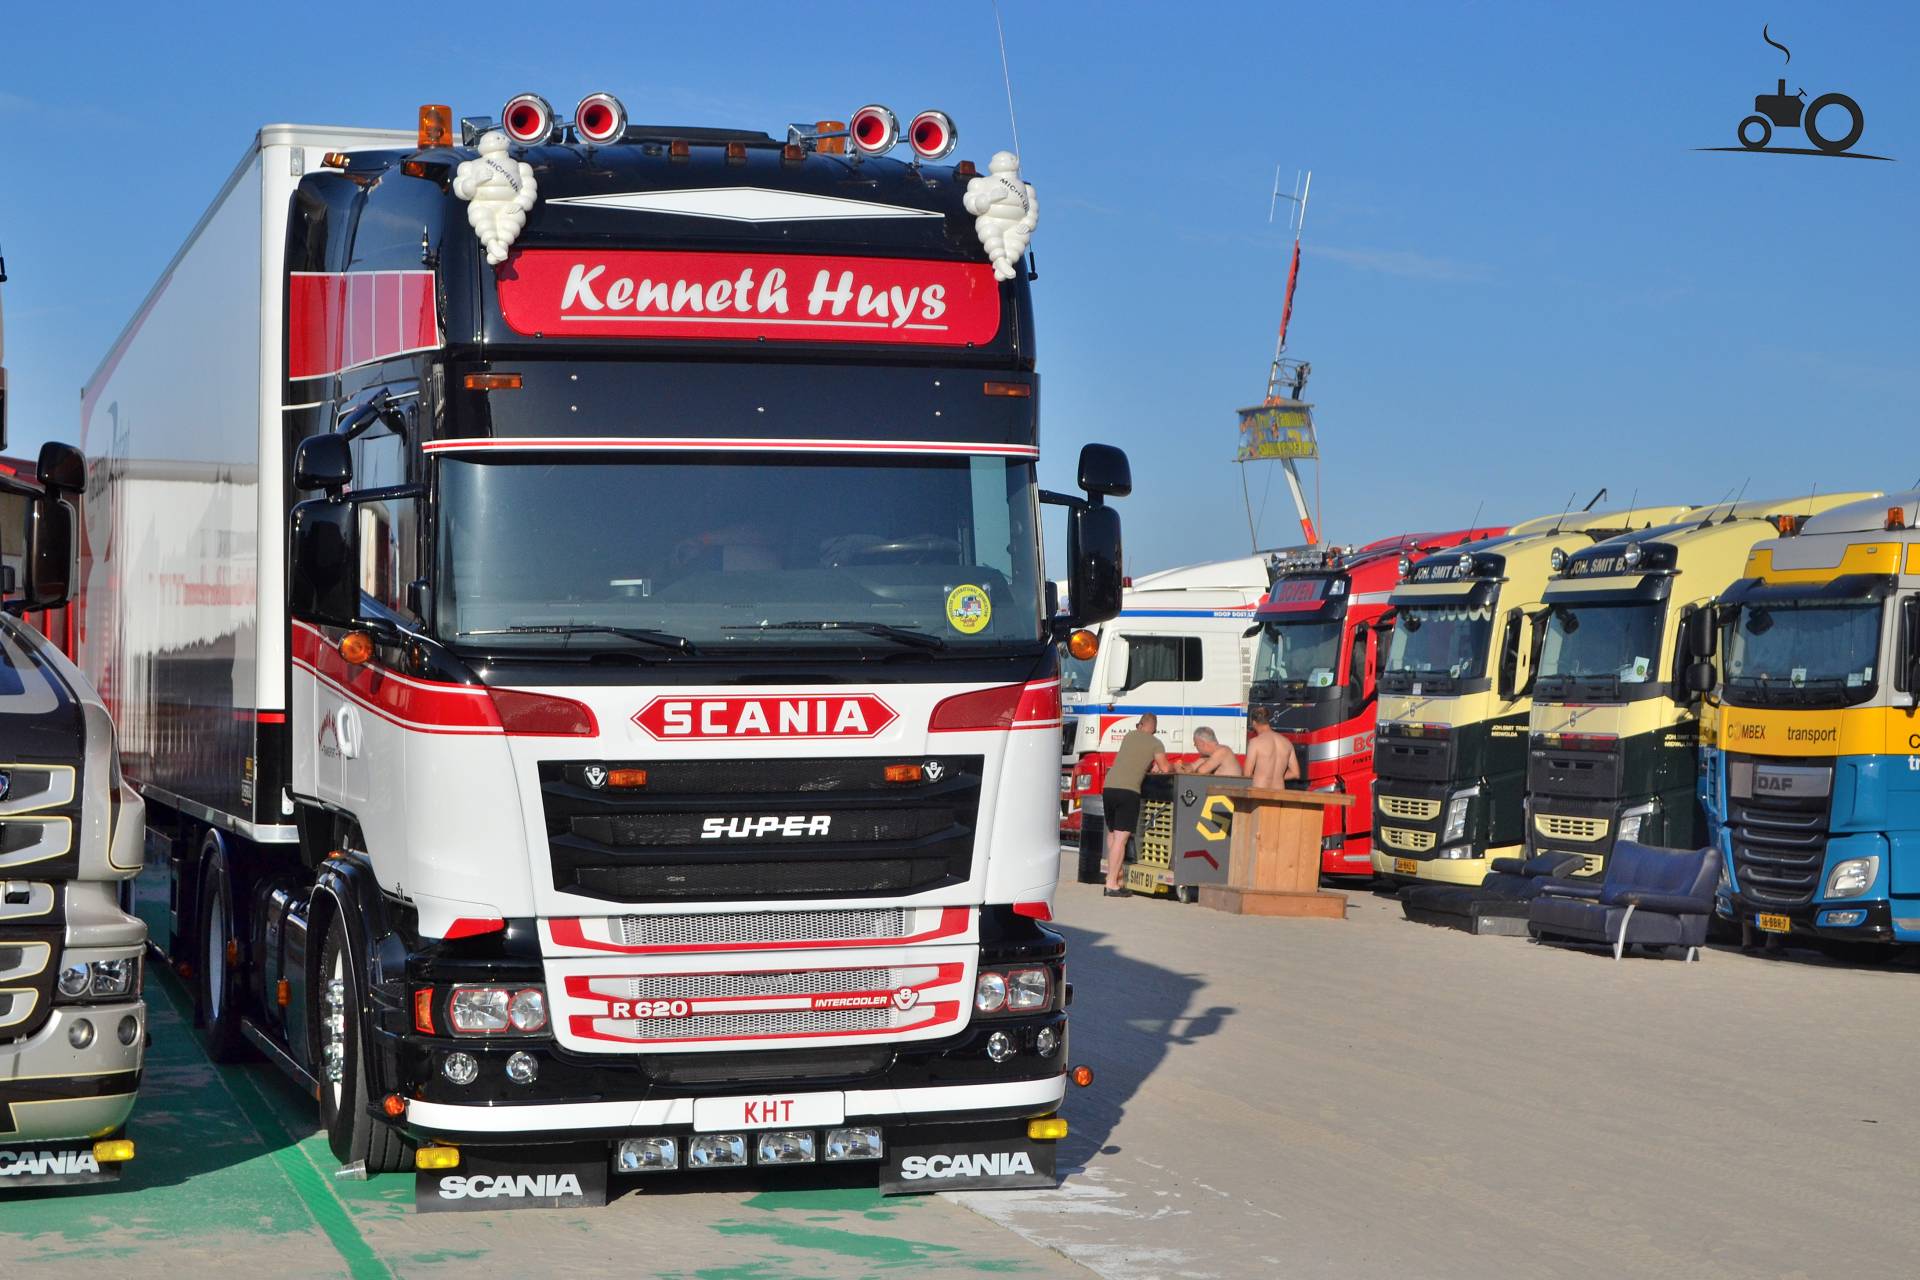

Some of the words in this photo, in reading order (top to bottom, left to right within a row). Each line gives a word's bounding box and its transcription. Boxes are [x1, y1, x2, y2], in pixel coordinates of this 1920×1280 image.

[486, 159, 519, 192] MICHELIN
[1000, 178, 1029, 214] MICHELIN
[560, 263, 790, 314] Kenneth
[807, 269, 947, 329] Huys
[1431, 566, 1453, 578] SMIT
[1570, 560, 1588, 574] JOH.
[1591, 558, 1615, 573] SMIT
[663, 700, 869, 734] SCANIA
[1084, 726, 1095, 735] 29
[1353, 733, 1376, 752] BO
[1728, 724, 1766, 740] CMBEX
[1788, 726, 1837, 744] transport
[1757, 776, 1793, 791] DAF
[700, 815, 832, 839] SUPER
[1130, 870, 1144, 886] SMIT
[612, 1002, 630, 1018] R
[635, 1000, 688, 1017] 620
[814, 995, 888, 1007] INTERCOOLER
[744, 1100, 794, 1124] KHT
[0, 1150, 100, 1175] CANIA
[901, 1151, 1035, 1180] SCANIA
[439, 1174, 583, 1200] SCANIA
